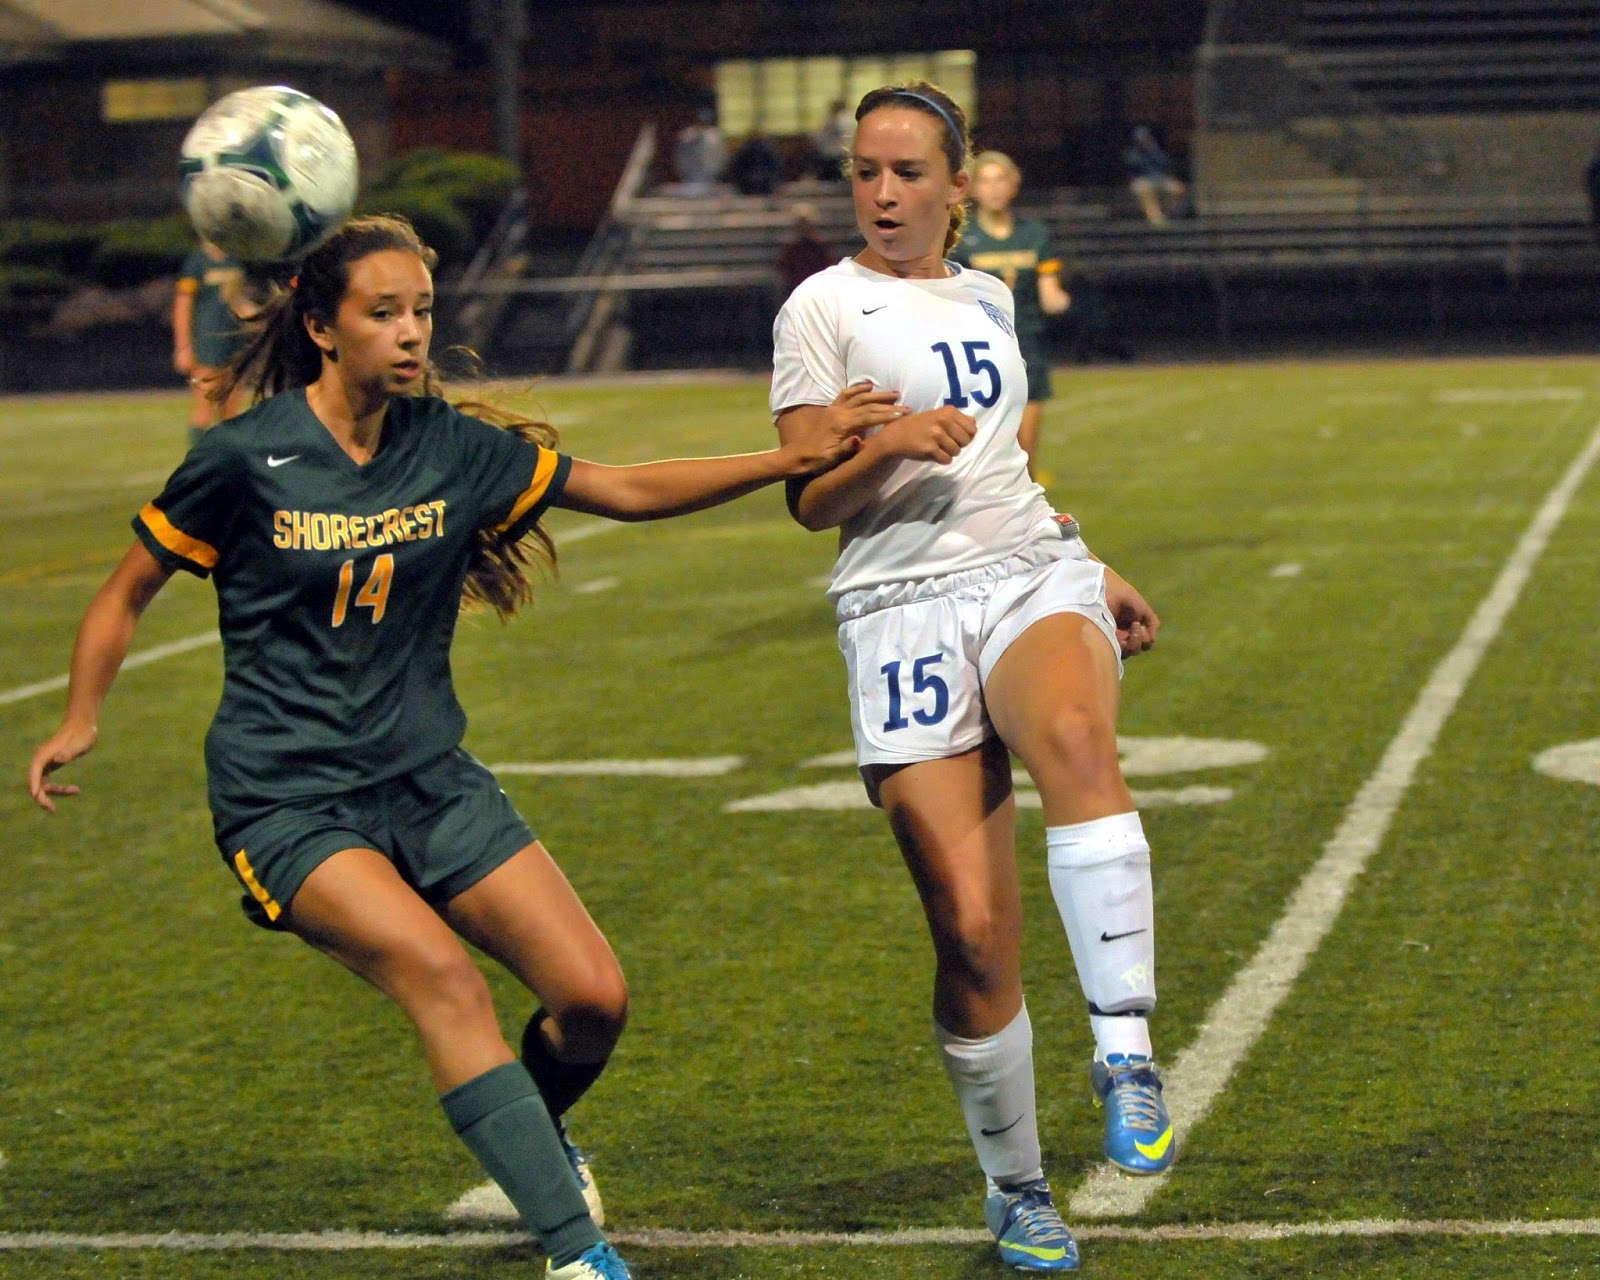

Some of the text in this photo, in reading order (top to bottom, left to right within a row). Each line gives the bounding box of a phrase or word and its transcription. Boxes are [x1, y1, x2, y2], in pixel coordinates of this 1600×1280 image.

[930, 341, 1002, 408] 15
[273, 500, 446, 550] SHORECREST
[332, 553, 395, 628] 14
[881, 652, 949, 733] 15
